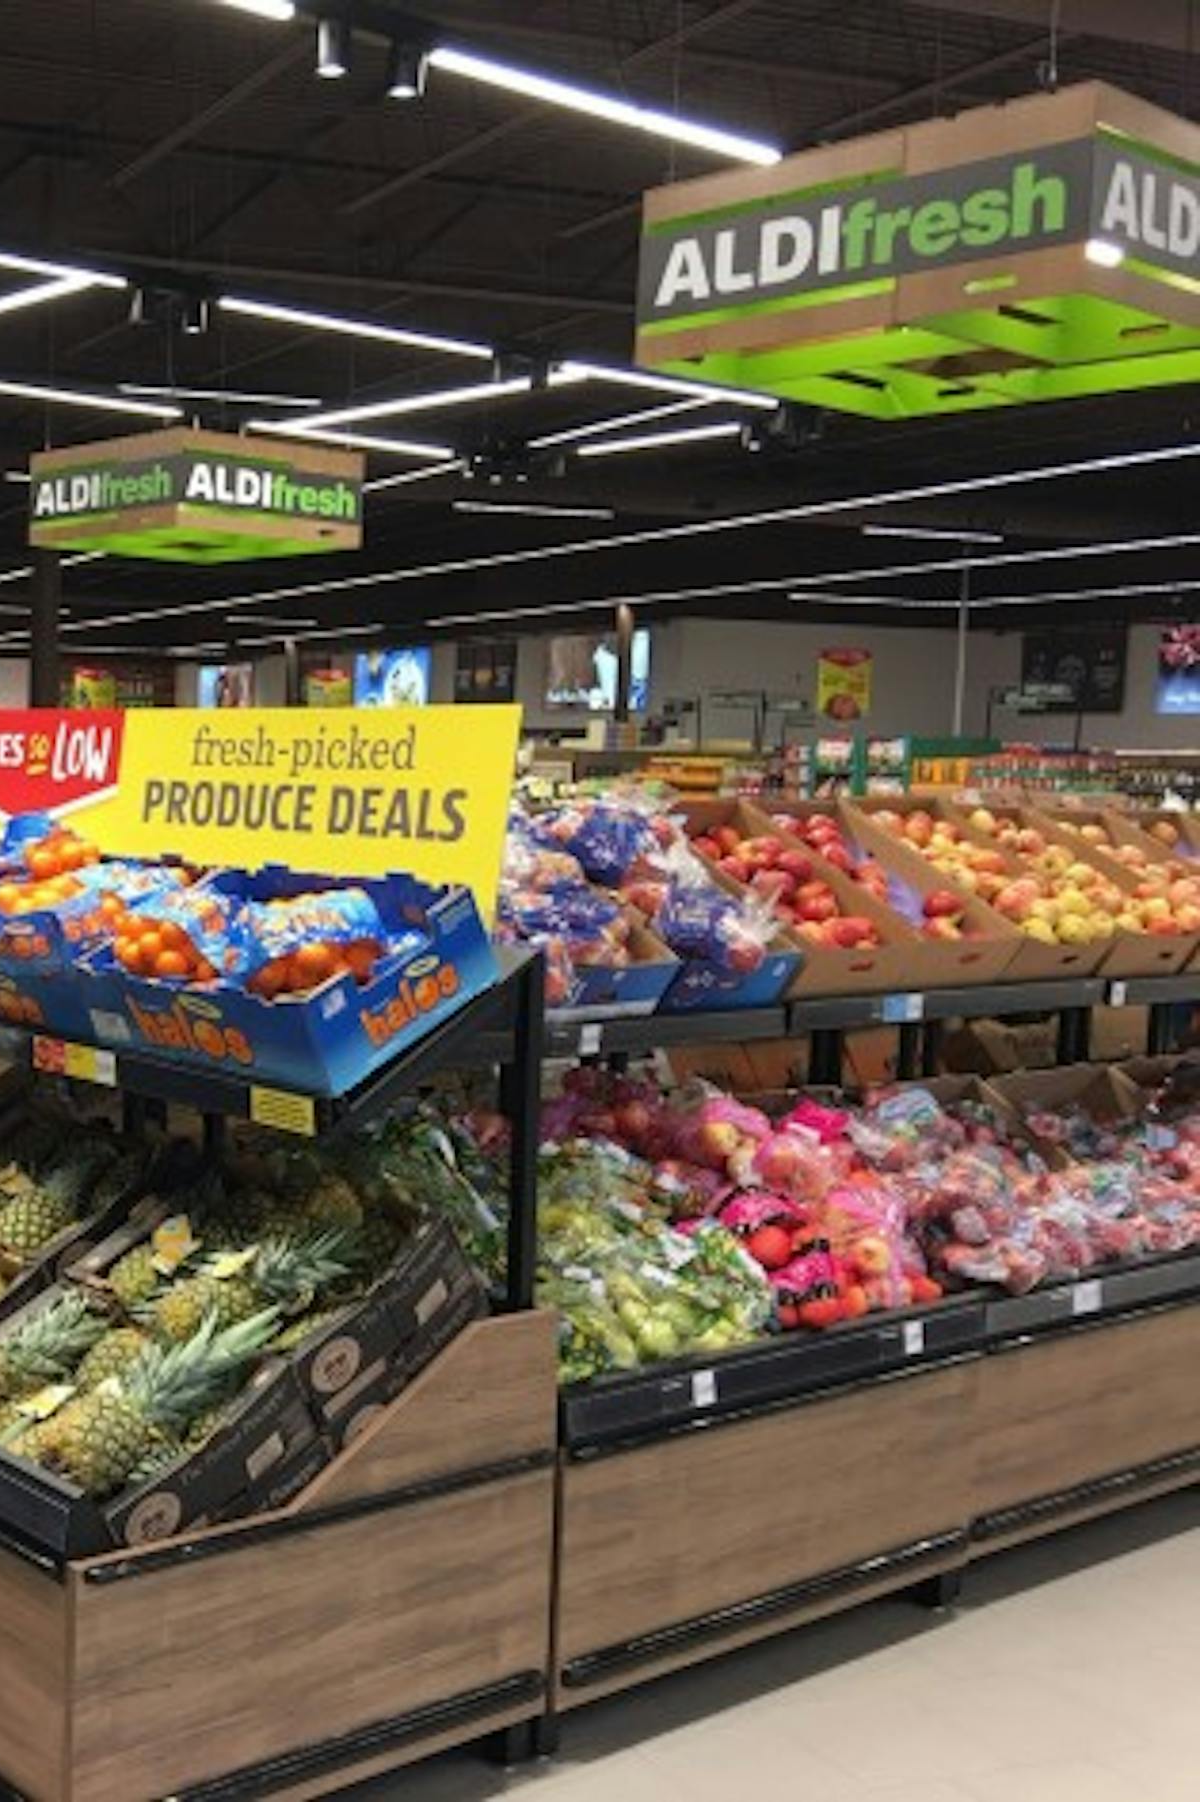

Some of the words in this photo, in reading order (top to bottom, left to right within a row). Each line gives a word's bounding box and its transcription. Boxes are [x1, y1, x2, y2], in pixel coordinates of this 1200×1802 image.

[1101, 160, 1199, 258] ALD
[52, 721, 113, 783] LOW
[191, 724, 417, 777] fresh-picked
[142, 779, 317, 833] PRODUCE
[327, 786, 468, 843] DEALS
